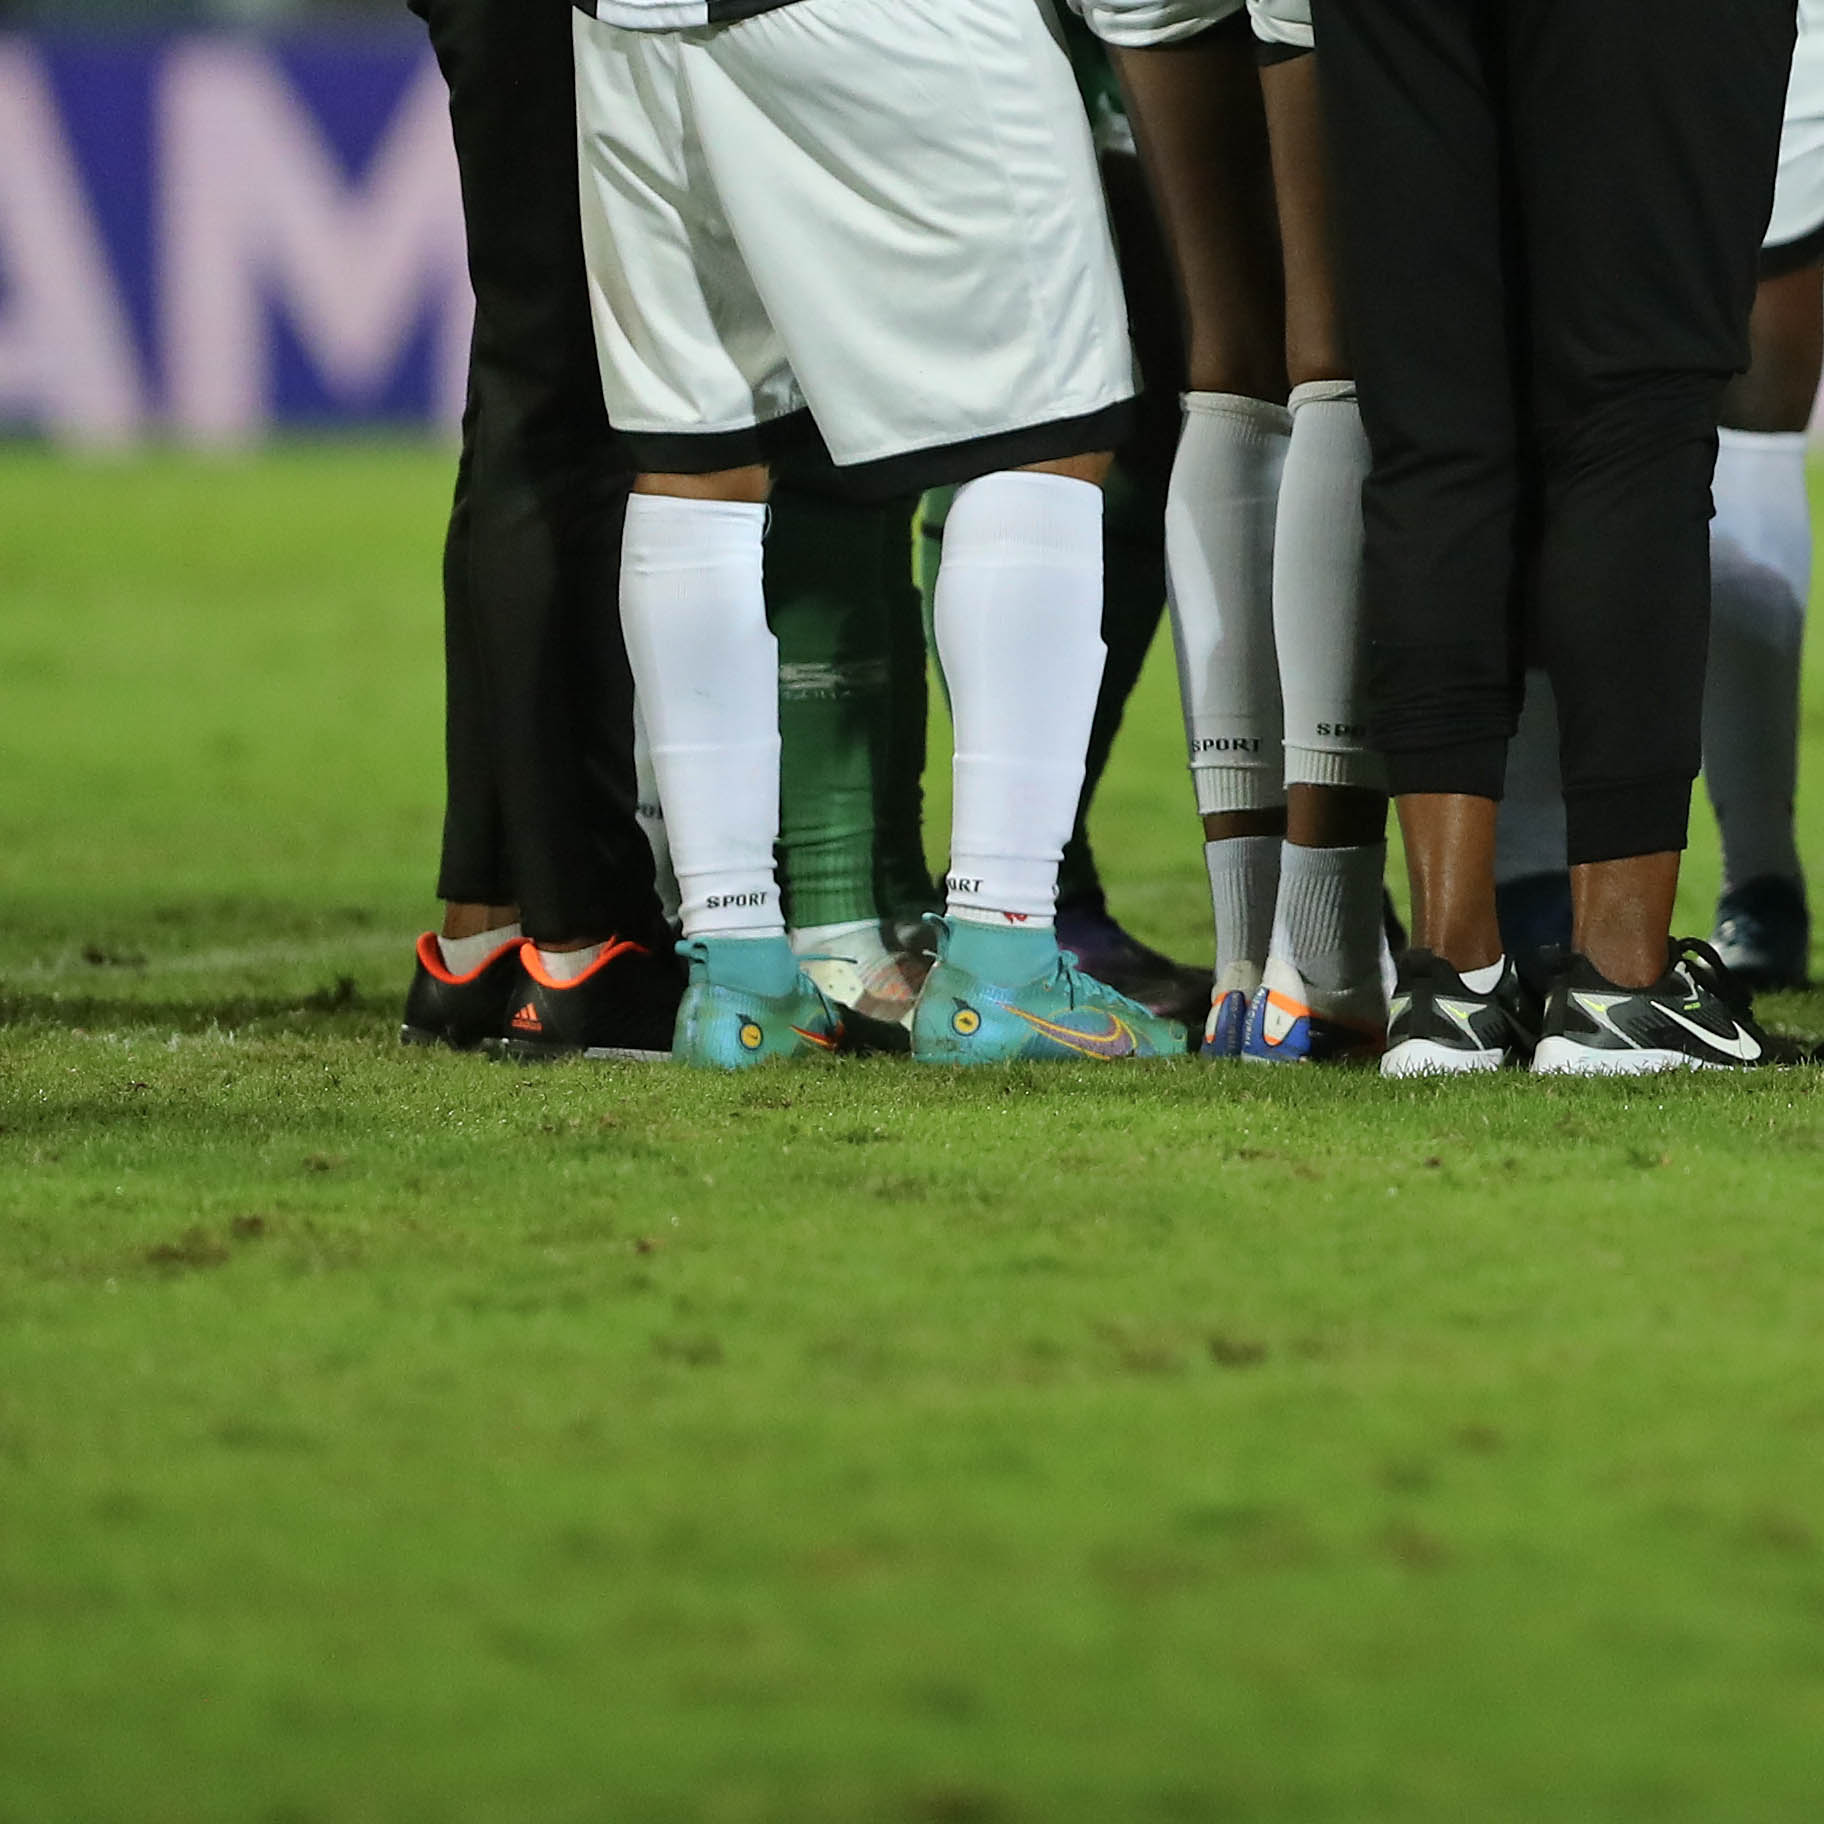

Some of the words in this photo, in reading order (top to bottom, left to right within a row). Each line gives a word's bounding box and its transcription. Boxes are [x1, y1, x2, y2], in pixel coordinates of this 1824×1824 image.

[1191, 737, 1263, 753] SPORT
[947, 877, 984, 894] ORT
[706, 890, 768, 909] SPORT
